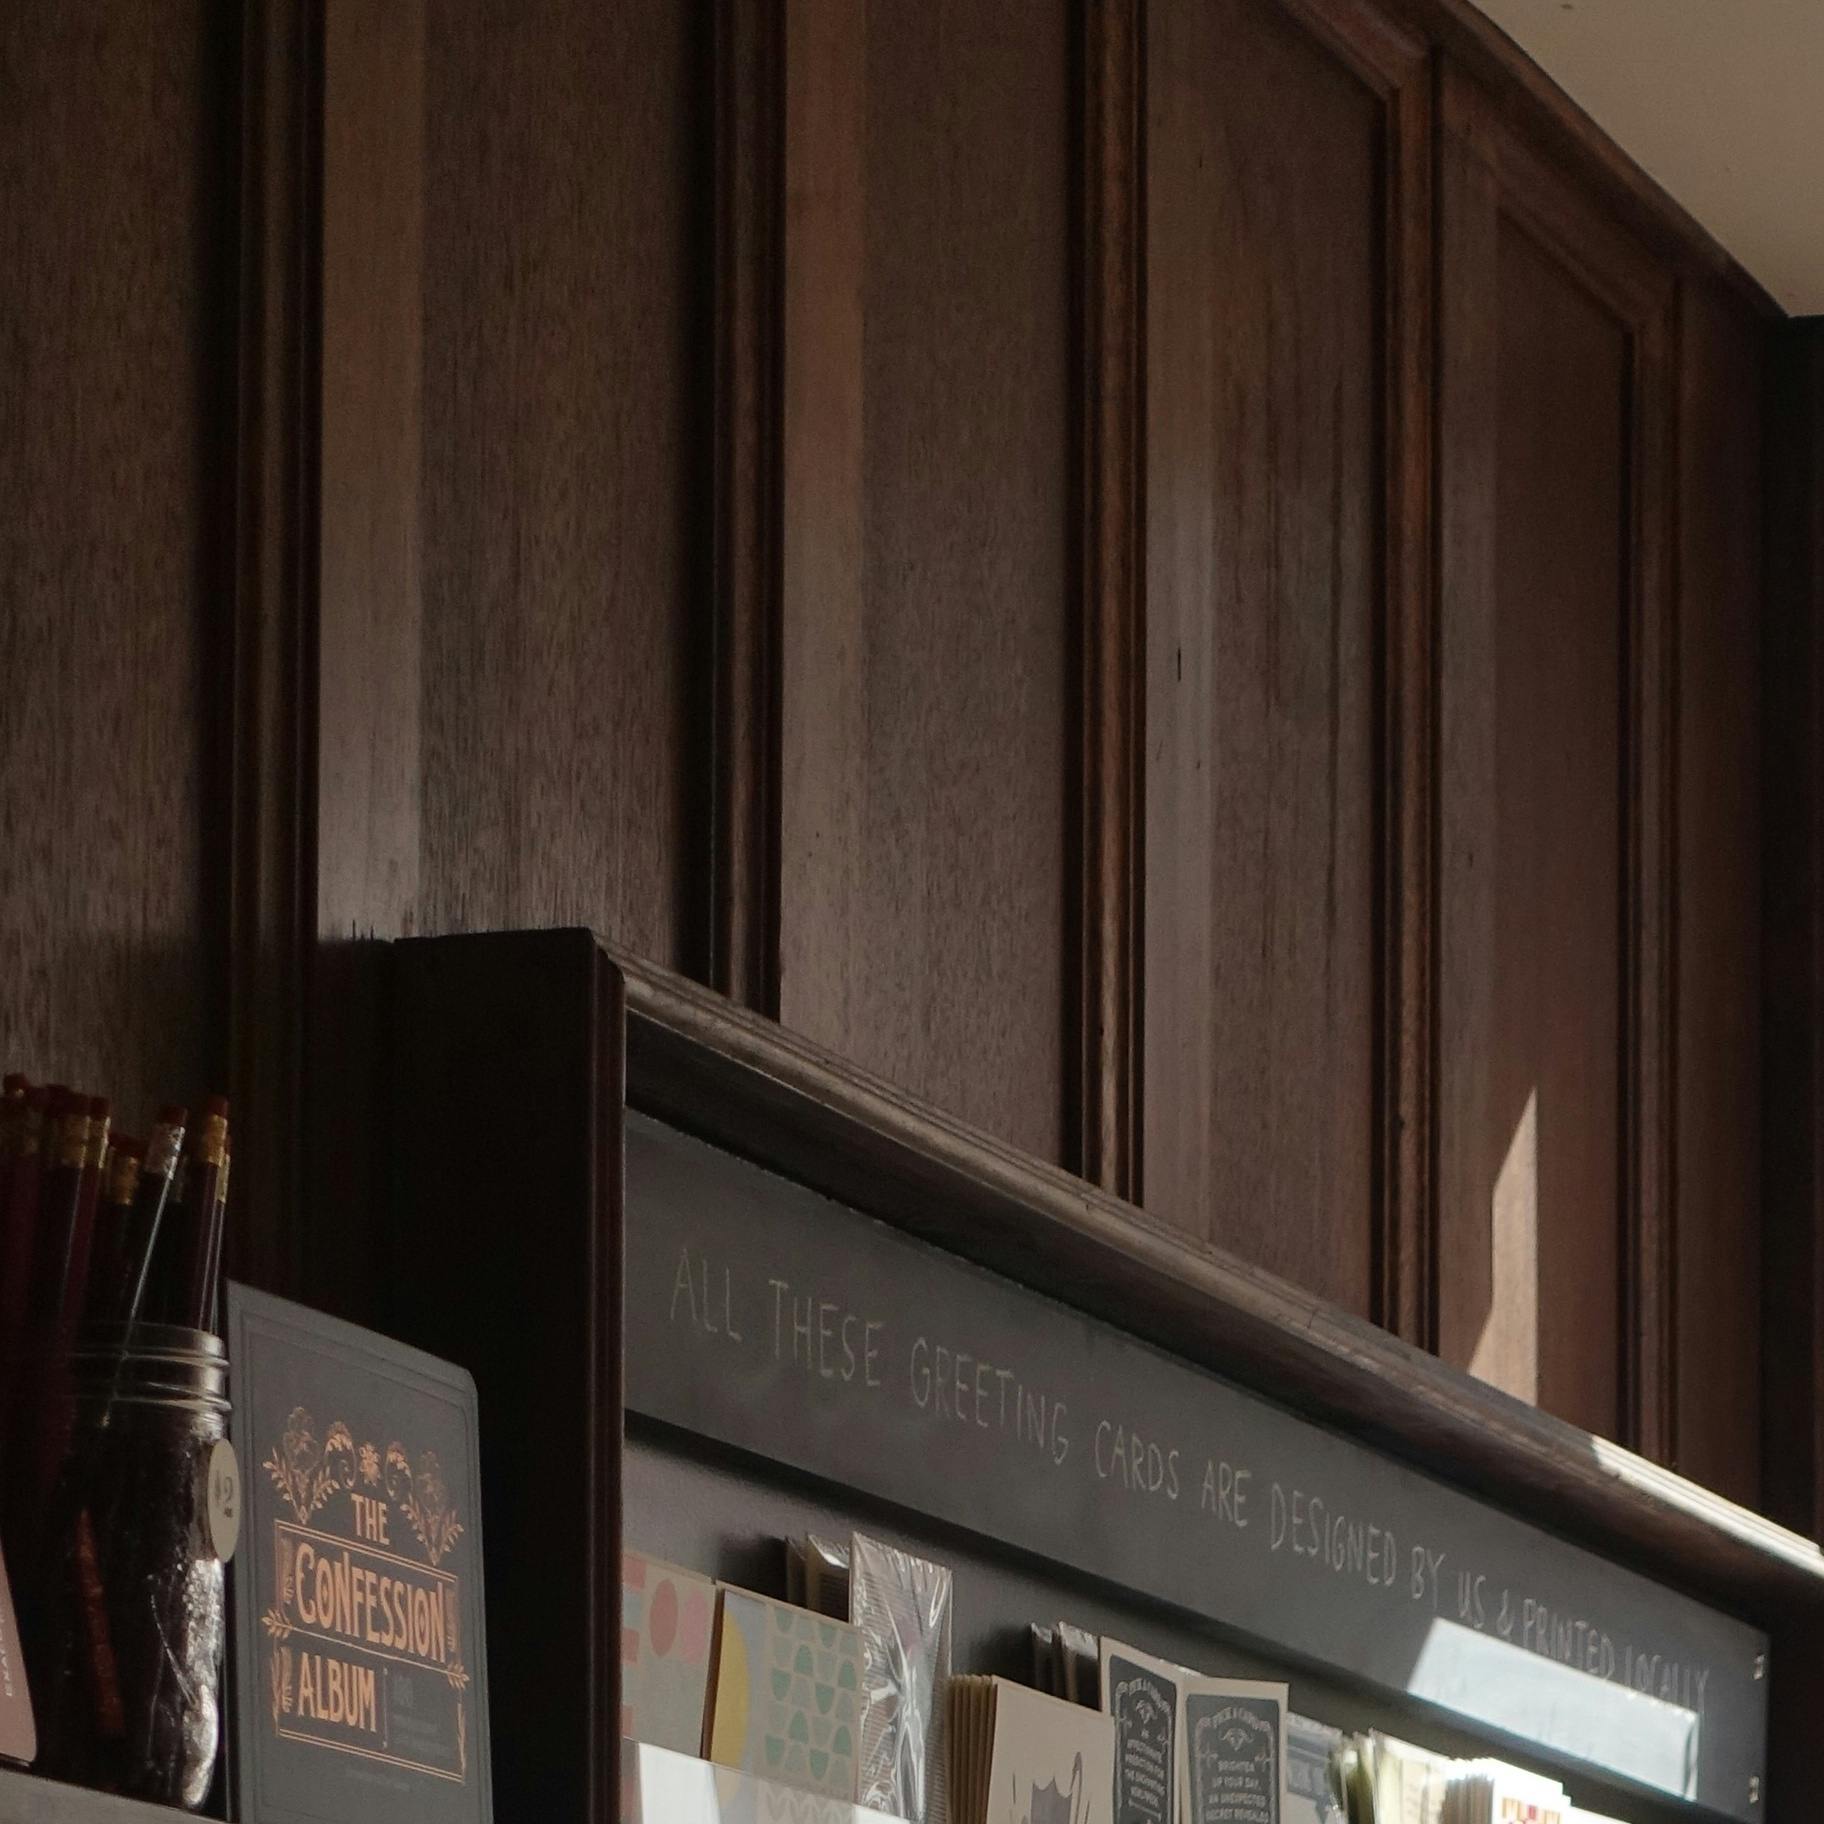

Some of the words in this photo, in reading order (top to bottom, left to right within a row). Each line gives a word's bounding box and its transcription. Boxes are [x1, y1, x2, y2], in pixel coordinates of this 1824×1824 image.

[670, 1248, 743, 1342] ALL
[768, 1279, 887, 1387] THESE
[910, 1336, 1069, 1466] GREETING
[1095, 1420, 1180, 1500] CARDS
[1201, 1459, 1250, 1527] ARE
[1271, 1481, 1397, 1587] DESIGNED
[1411, 1546, 1447, 1609] BY
[1457, 1570, 1487, 1630] US
[1523, 1598, 1617, 1682] PRINTED
[351, 1493, 390, 1546] THE
[294, 1542, 447, 1664] CONFESSION
[297, 1659, 377, 1735] ALBUM
